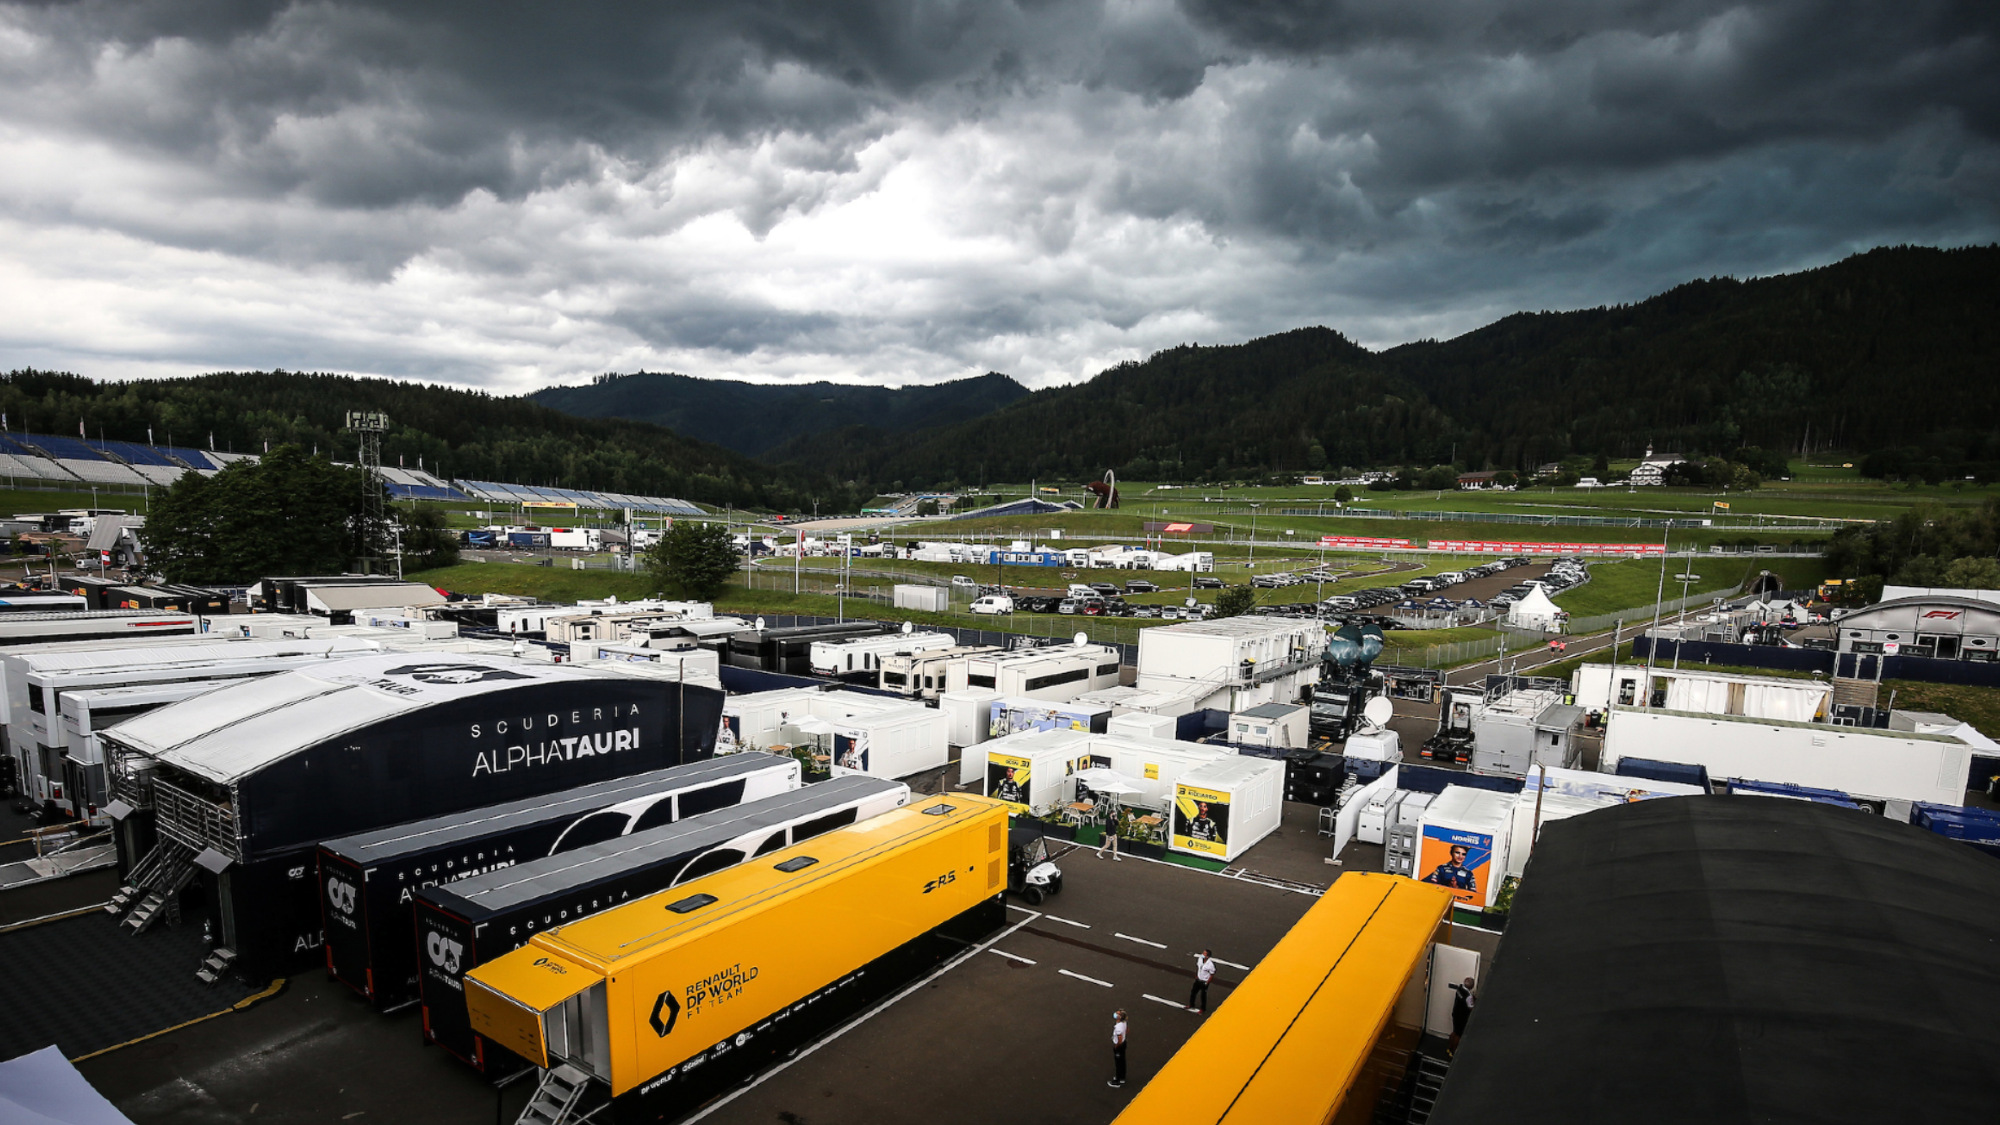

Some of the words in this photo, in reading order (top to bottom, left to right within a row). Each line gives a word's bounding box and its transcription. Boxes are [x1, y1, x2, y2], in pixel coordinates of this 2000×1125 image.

[1921, 610, 1963, 620] F1
[471, 703, 640, 738] SCUDERIA
[472, 727, 640, 777] ALPHATAURI
[1451, 834, 1480, 845] NORRIS
[398, 844, 514, 880] SCUDERIA
[509, 890, 629, 935] SCUDERIA
[686, 963, 741, 996] RENAULT
[686, 990, 706, 1011] DP
[708, 966, 759, 998] WORLD
[709, 986, 743, 1008] TEAM
